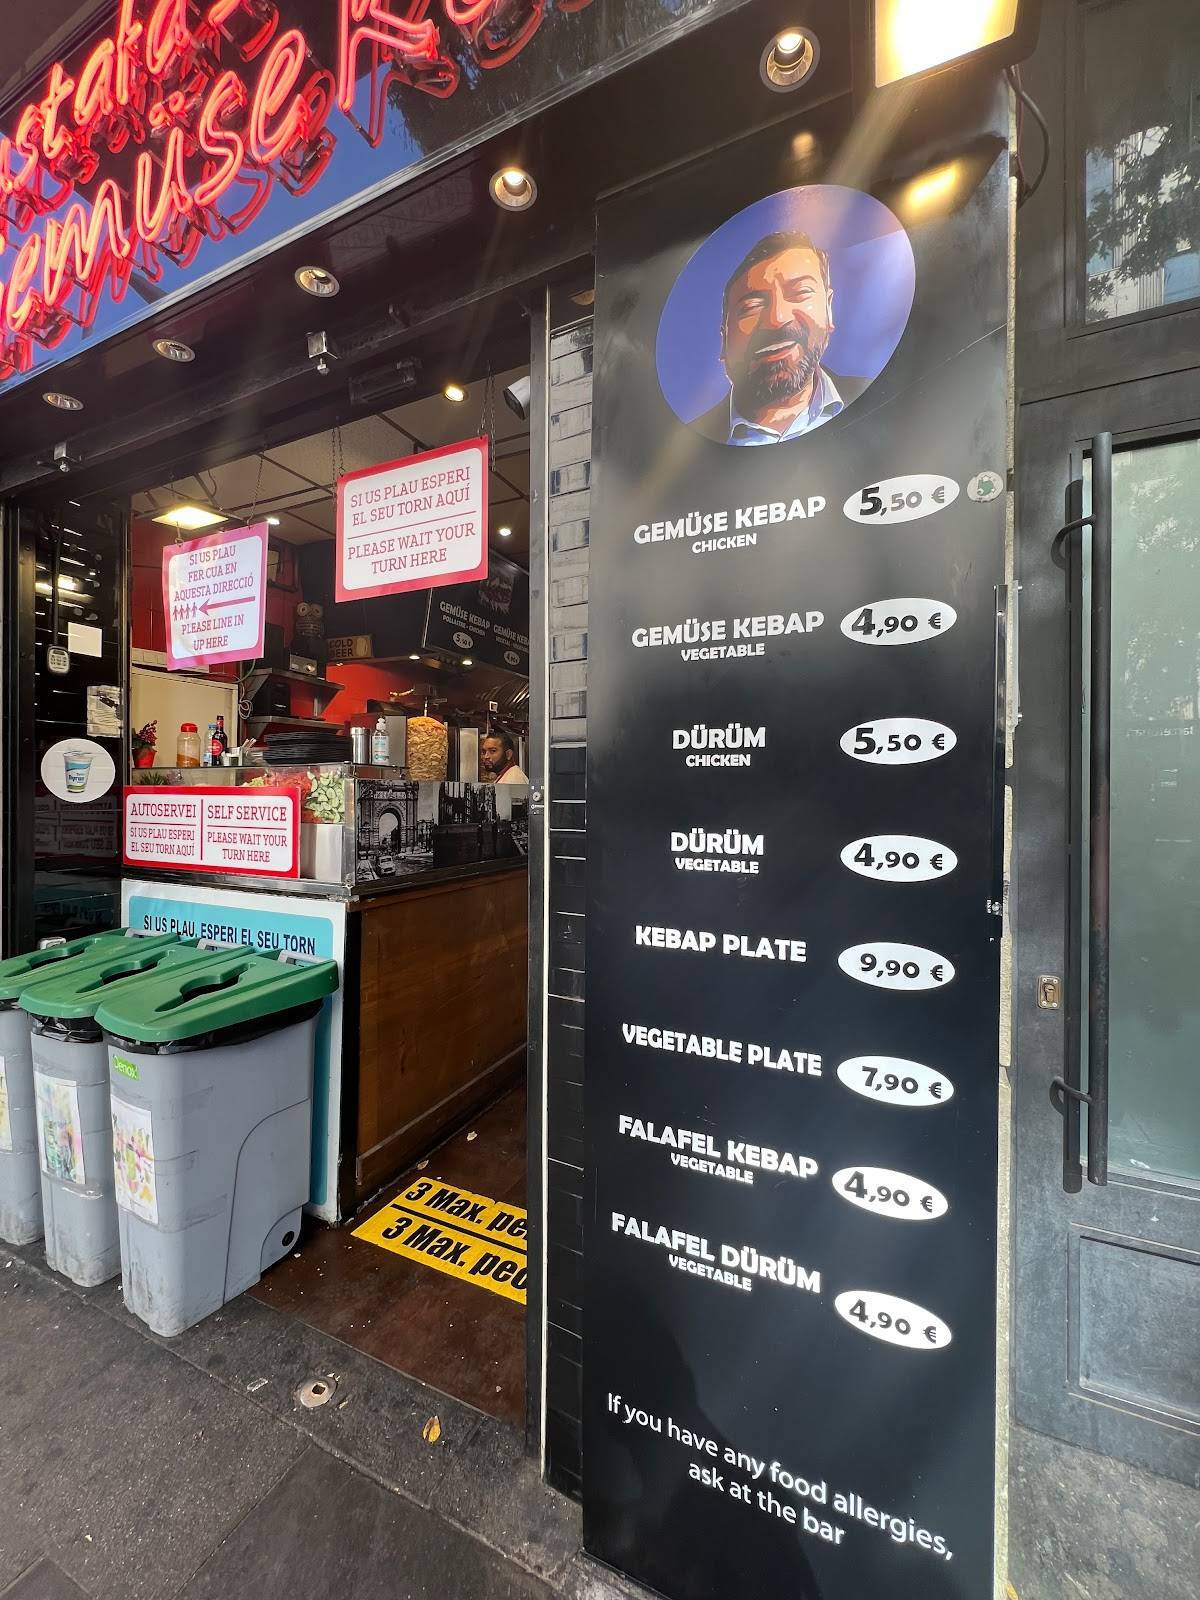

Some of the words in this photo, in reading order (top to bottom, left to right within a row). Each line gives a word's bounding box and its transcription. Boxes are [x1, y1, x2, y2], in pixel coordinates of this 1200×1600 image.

[351, 493, 362, 508] SI
[365, 489, 381, 505] US
[384, 480, 418, 502] PLAU
[421, 467, 470, 491] ESPERI
[859, 487, 922, 517] 5,50
[931, 485, 945, 504] €
[352, 511, 367, 526] EL
[370, 505, 396, 522] SEU
[397, 496, 433, 516] TORN
[435, 483, 470, 507] AQUÍ
[634, 511, 728, 544] GEMÜSE
[735, 495, 826, 529] KEBAP
[189, 554, 198, 566] SI
[199, 550, 211, 563] US
[212, 545, 236, 561] PLAU
[347, 539, 395, 560] PLEASE
[397, 531, 433, 550] WAIT
[436, 522, 476, 543] YOUR
[692, 533, 757, 554] CHICKEN
[188, 570, 204, 582] FER
[205, 565, 224, 580] CUA
[225, 562, 237, 574] EN
[371, 557, 407, 574] TURN
[410, 548, 447, 568] HERE
[174, 586, 212, 601] AQUESTA
[213, 572, 254, 594] DIRECCIÓ
[181, 620, 212, 635] PLEASE
[213, 616, 233, 630] LINE
[234, 613, 245, 625] IN
[631, 618, 726, 648] GEMÜSE
[733, 611, 825, 640] KEBAP
[851, 608, 918, 638] 4,90
[928, 612, 942, 630] €
[193, 640, 206, 650] UP
[206, 635, 229, 649] HERE
[681, 643, 765, 661] VEGETABLE
[673, 723, 766, 750] DÜRÜM
[853, 727, 922, 755] 5,50
[931, 733, 945, 750] €
[686, 754, 751, 767] CHICKEN
[130, 803, 196, 818] AUTOSERVEI
[207, 805, 235, 820] SELF
[236, 806, 287, 821] SERVICE
[130, 827, 137, 838] SI
[138, 828, 148, 839] US
[148, 828, 169, 840] PLAU
[169, 830, 195, 841] ESPERI
[207, 831, 238, 845] PLEASE
[239, 833, 263, 846] WAIT
[263, 834, 287, 847] YOUR
[671, 828, 764, 856] DÜRÜM
[131, 842, 140, 852] EL
[140, 842, 156, 853] SEU
[156, 844, 175, 855] TORN
[175, 843, 195, 856] AQUÍ
[222, 848, 246, 861] TURN
[247, 850, 271, 862] HERE
[853, 843, 920, 871] 4,90
[930, 853, 943, 871] €
[675, 857, 760, 874] VEGETABLE
[143, 915, 152, 931] SI
[155, 916, 167, 933] US
[201, 922, 238, 944] ESPERI
[241, 928, 254, 947] EL
[257, 930, 279, 950] SEU
[282, 933, 316, 956] TORN
[635, 925, 716, 951] KEBAP
[722, 934, 807, 963] PLATE
[860, 953, 920, 980] 9,90
[930, 964, 944, 982] €
[622, 1023, 743, 1064] VEGETABLE
[747, 1043, 823, 1077] PLATE
[861, 1065, 919, 1094] 7,90
[928, 1081, 942, 1099] €
[618, 1114, 721, 1159] FALAFEL
[727, 1140, 819, 1178] KEBAP
[670, 1152, 754, 1185] VEGETABLE
[843, 1170, 910, 1207] 4,90
[919, 1195, 933, 1213] €
[405, 1182, 433, 1201] 3
[423, 1188, 488, 1225] Max.
[485, 1211, 527, 1240] pe
[381, 1217, 413, 1239] 3
[401, 1223, 471, 1267] Max.
[611, 1212, 715, 1262] FALAFEL
[721, 1244, 821, 1294] DÜRÜM
[668, 1254, 752, 1292] VEGETABLE
[848, 1299, 912, 1336] 4,90
[923, 1325, 937, 1344] €
[607, 1392, 622, 1414] If
[624, 1402, 662, 1434] you
[668, 1417, 719, 1457] have
[723, 1444, 766, 1479] any
[769, 1461, 827, 1505] food
[833, 1487, 954, 1561] allergies,
[688, 1461, 725, 1492] ask
[729, 1479, 752, 1504] at
[756, 1490, 797, 1524] the
[802, 1507, 846, 1545] bar
